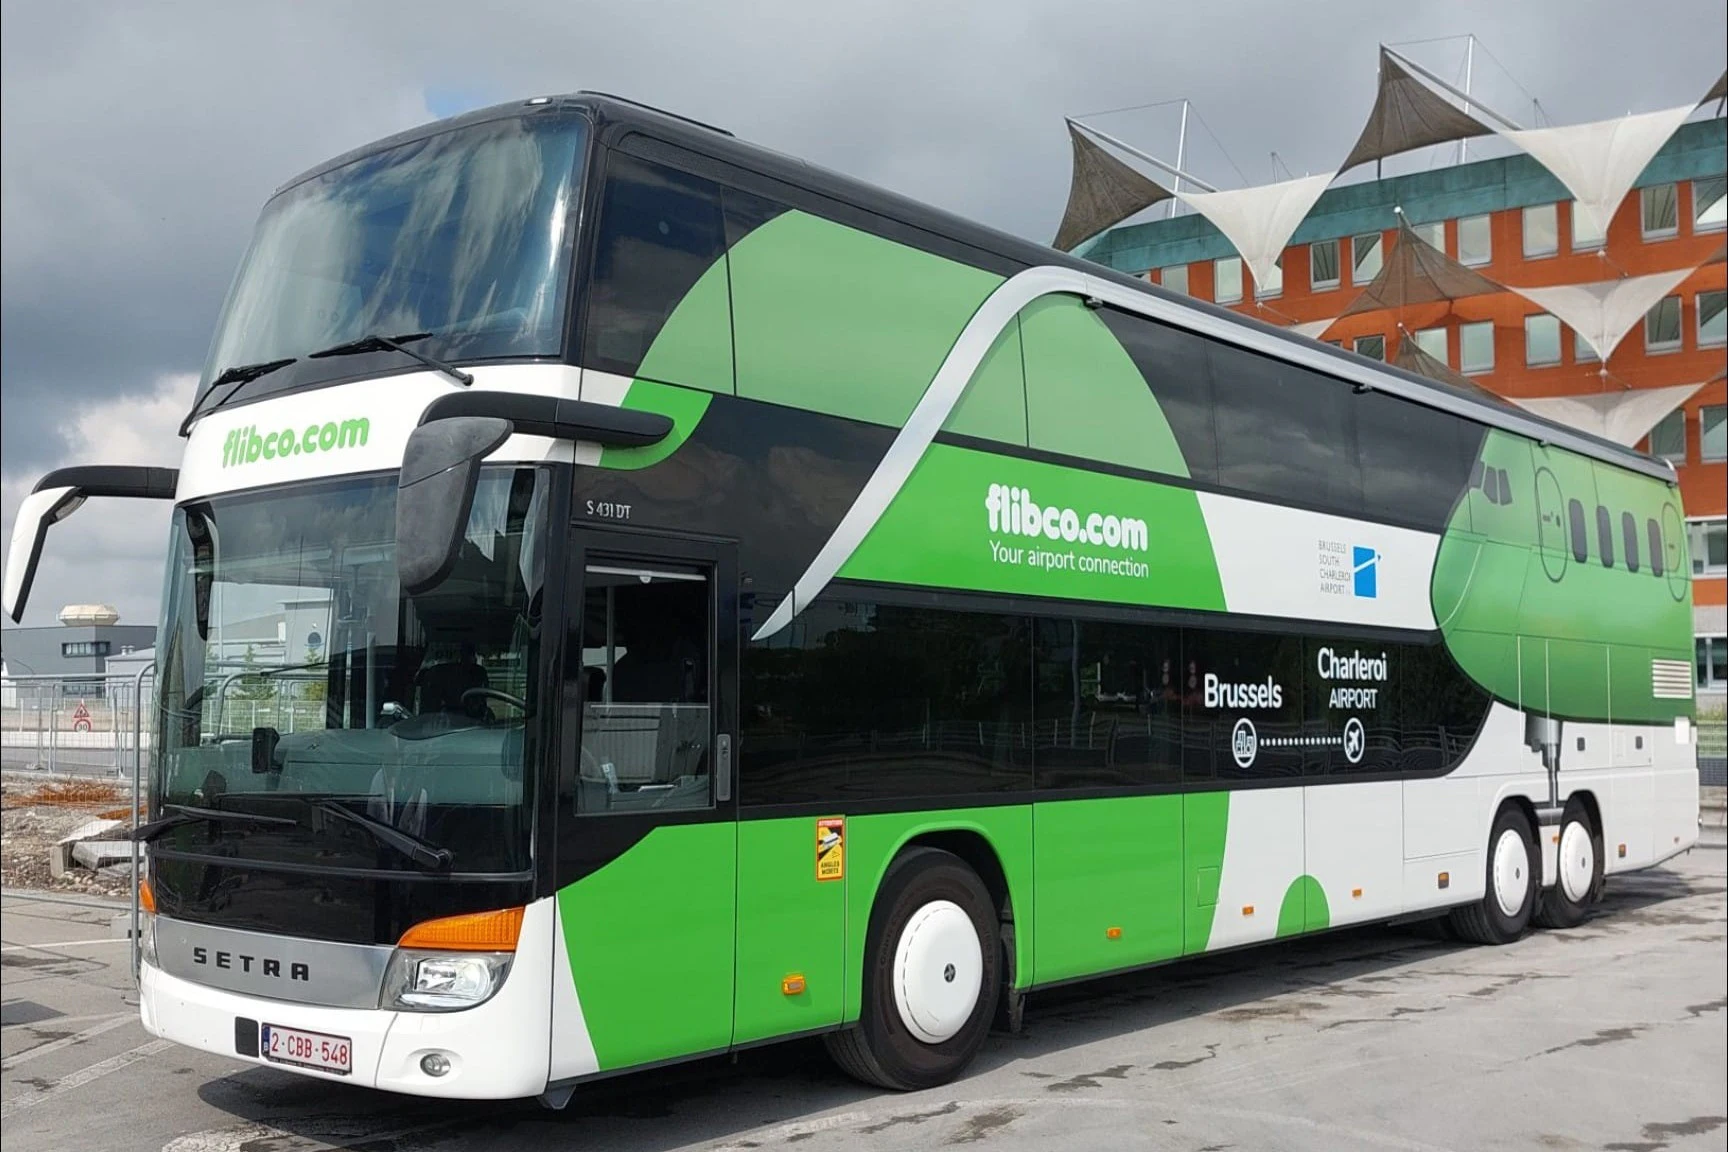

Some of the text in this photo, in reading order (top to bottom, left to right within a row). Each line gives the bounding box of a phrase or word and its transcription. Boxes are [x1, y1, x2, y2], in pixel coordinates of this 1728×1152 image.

[222, 417, 370, 469] flibco.com
[586, 500, 632, 519] S 431 DT
[985, 483, 1148, 552] flibco.com
[989, 539, 1149, 578] Your airport connection
[1318, 539, 1347, 554] BRUSSELS
[1319, 554, 1340, 567] SOUTH
[1320, 582, 1345, 595] AIRPORT
[1317, 647, 1387, 681] Charleroi
[1204, 673, 1282, 709] Brussels
[1328, 688, 1378, 709] AIRPORT
[194, 947, 309, 981] SETRA
